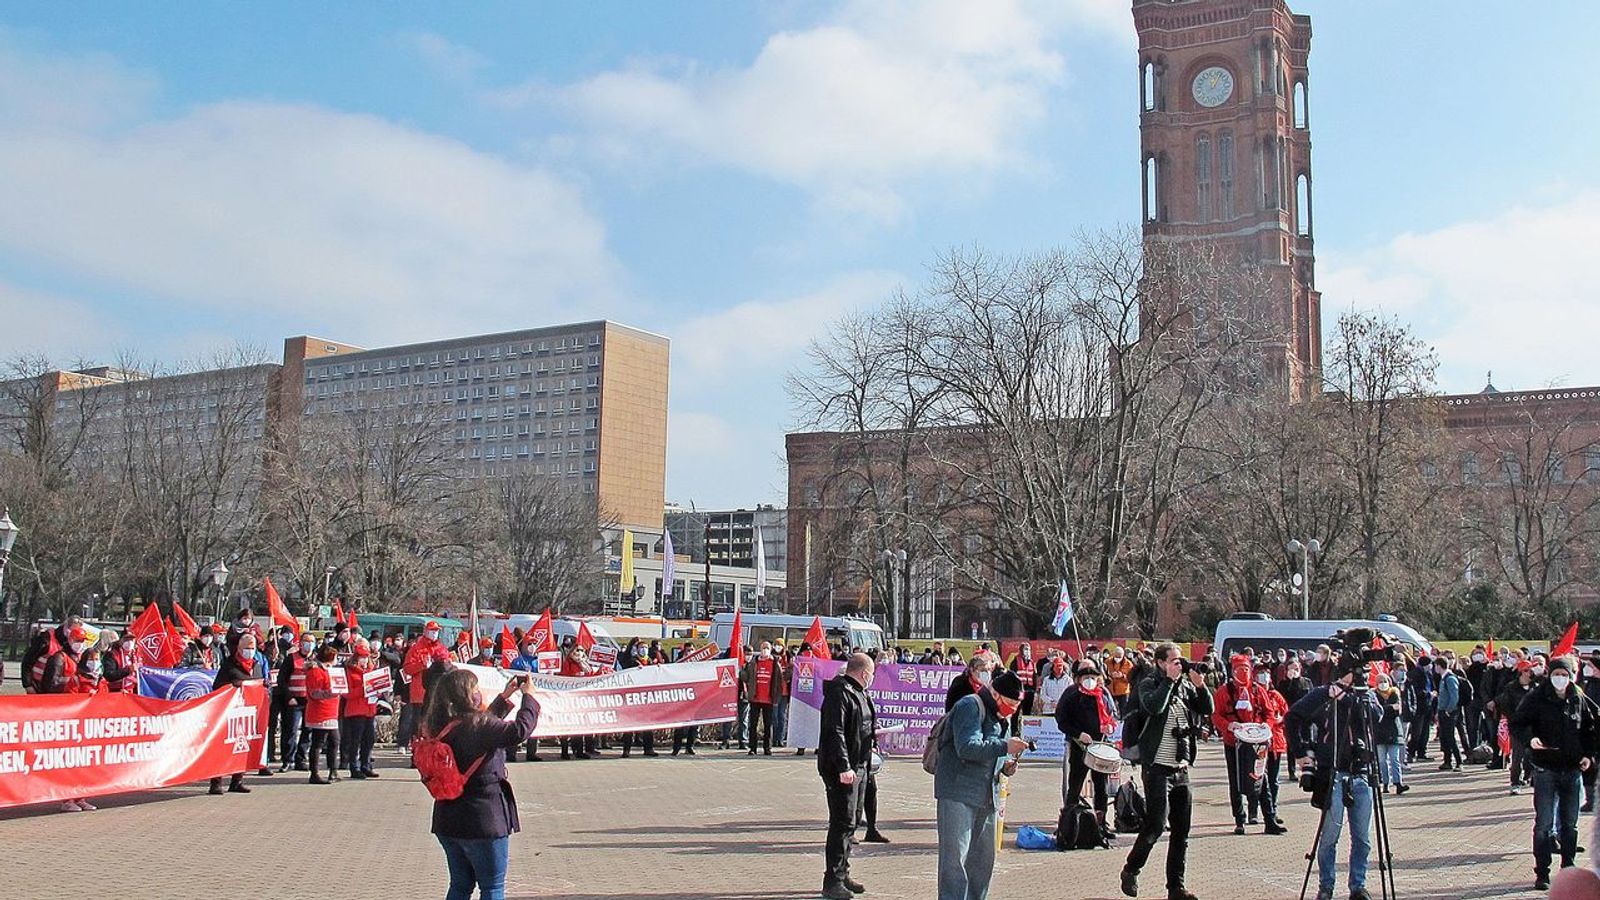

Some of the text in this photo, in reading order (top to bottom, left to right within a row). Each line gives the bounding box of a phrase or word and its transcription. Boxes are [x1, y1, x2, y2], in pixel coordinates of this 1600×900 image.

[598, 694, 623, 709] UND
[625, 687, 696, 706] ERFAHRUNG
[881, 690, 900, 700] UNS
[900, 691, 928, 703] NICHT
[587, 709, 618, 725] WEG!
[882, 704, 921, 716] STELLEN,
[21, 718, 83, 744] ARBEIT,
[83, 715, 138, 740] UNSERE
[877, 717, 909, 728] STEHEN
[32, 745, 103, 772] ZUKUNFT
